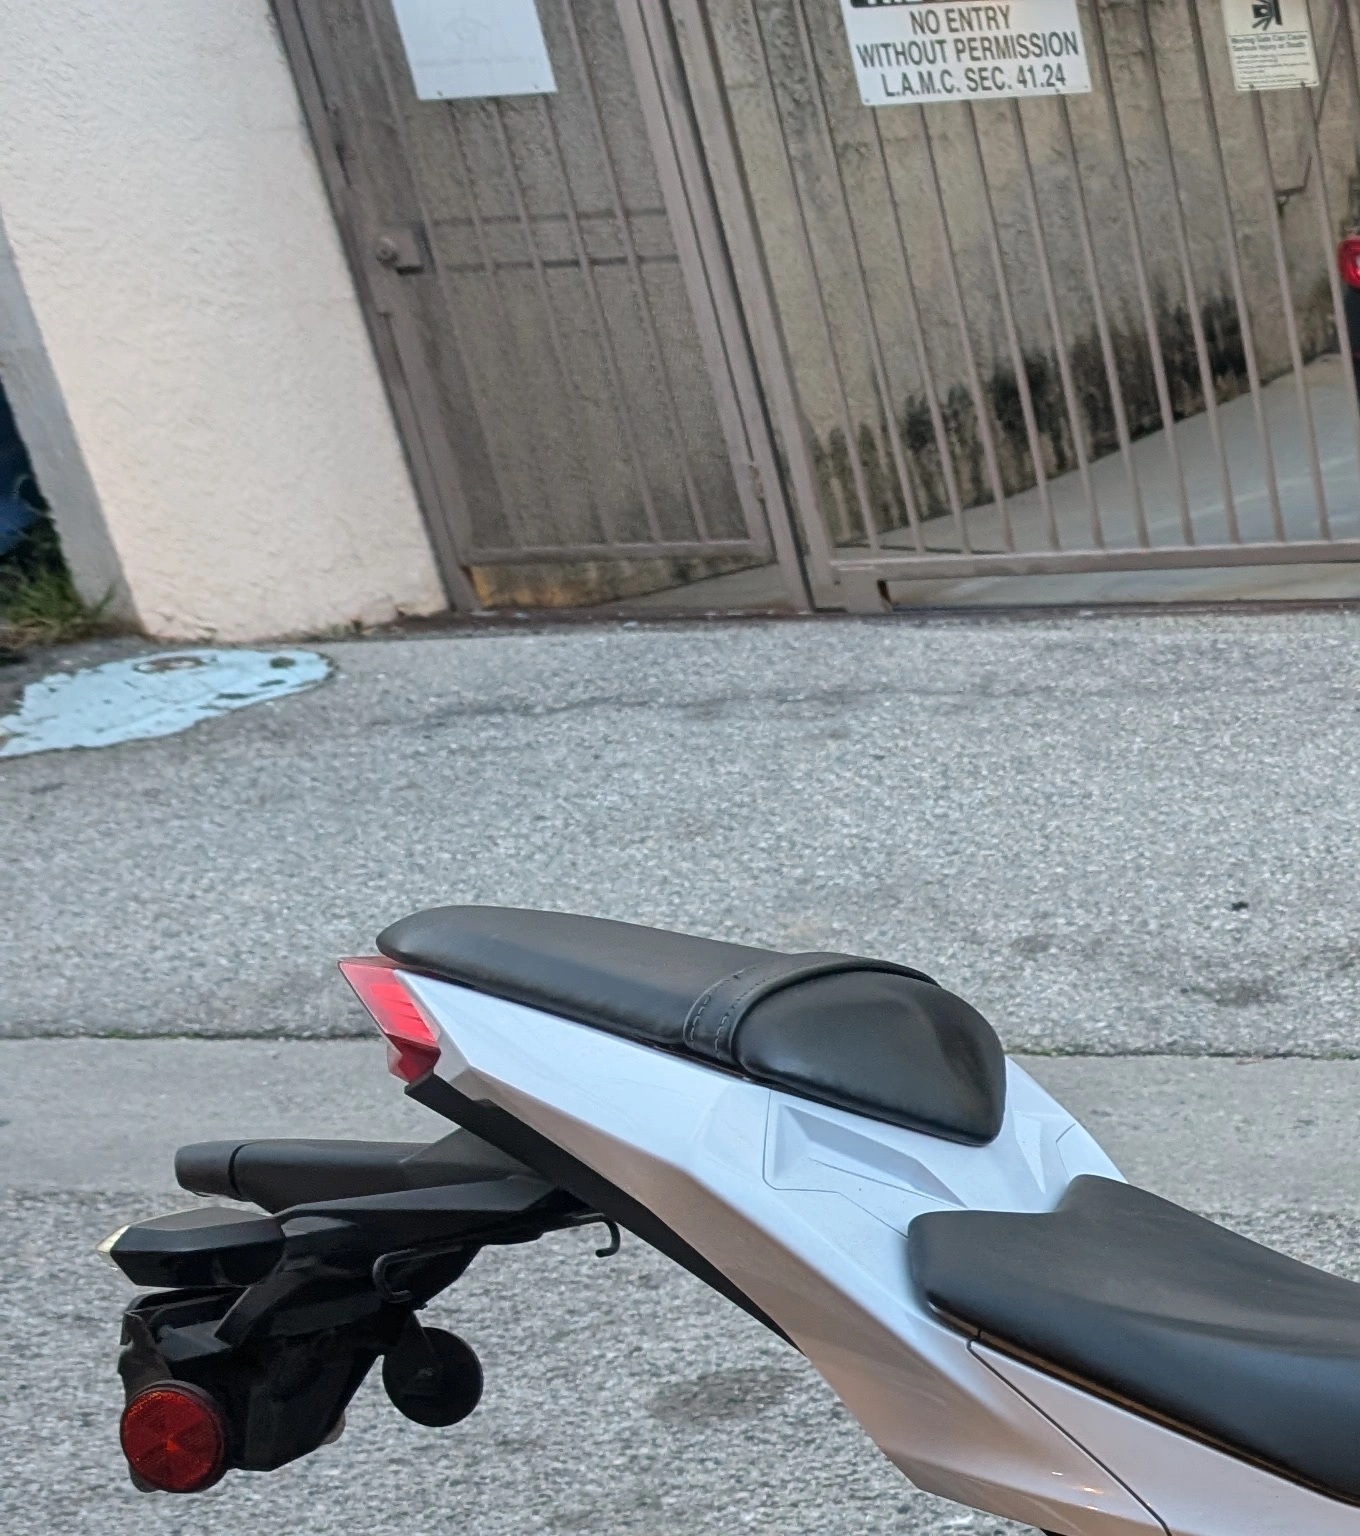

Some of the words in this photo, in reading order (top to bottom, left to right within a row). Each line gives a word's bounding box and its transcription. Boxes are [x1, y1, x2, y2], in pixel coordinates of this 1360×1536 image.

[909, 10, 941, 36] NO
[946, 5, 1011, 33] ENTRY
[855, 39, 949, 68] WITHOUT
[953, 31, 1080, 63] PERMISSION
[880, 69, 962, 97] L.A.M.C.
[964, 65, 1013, 93] SEC.
[1016, 62, 1067, 89] 41.24
